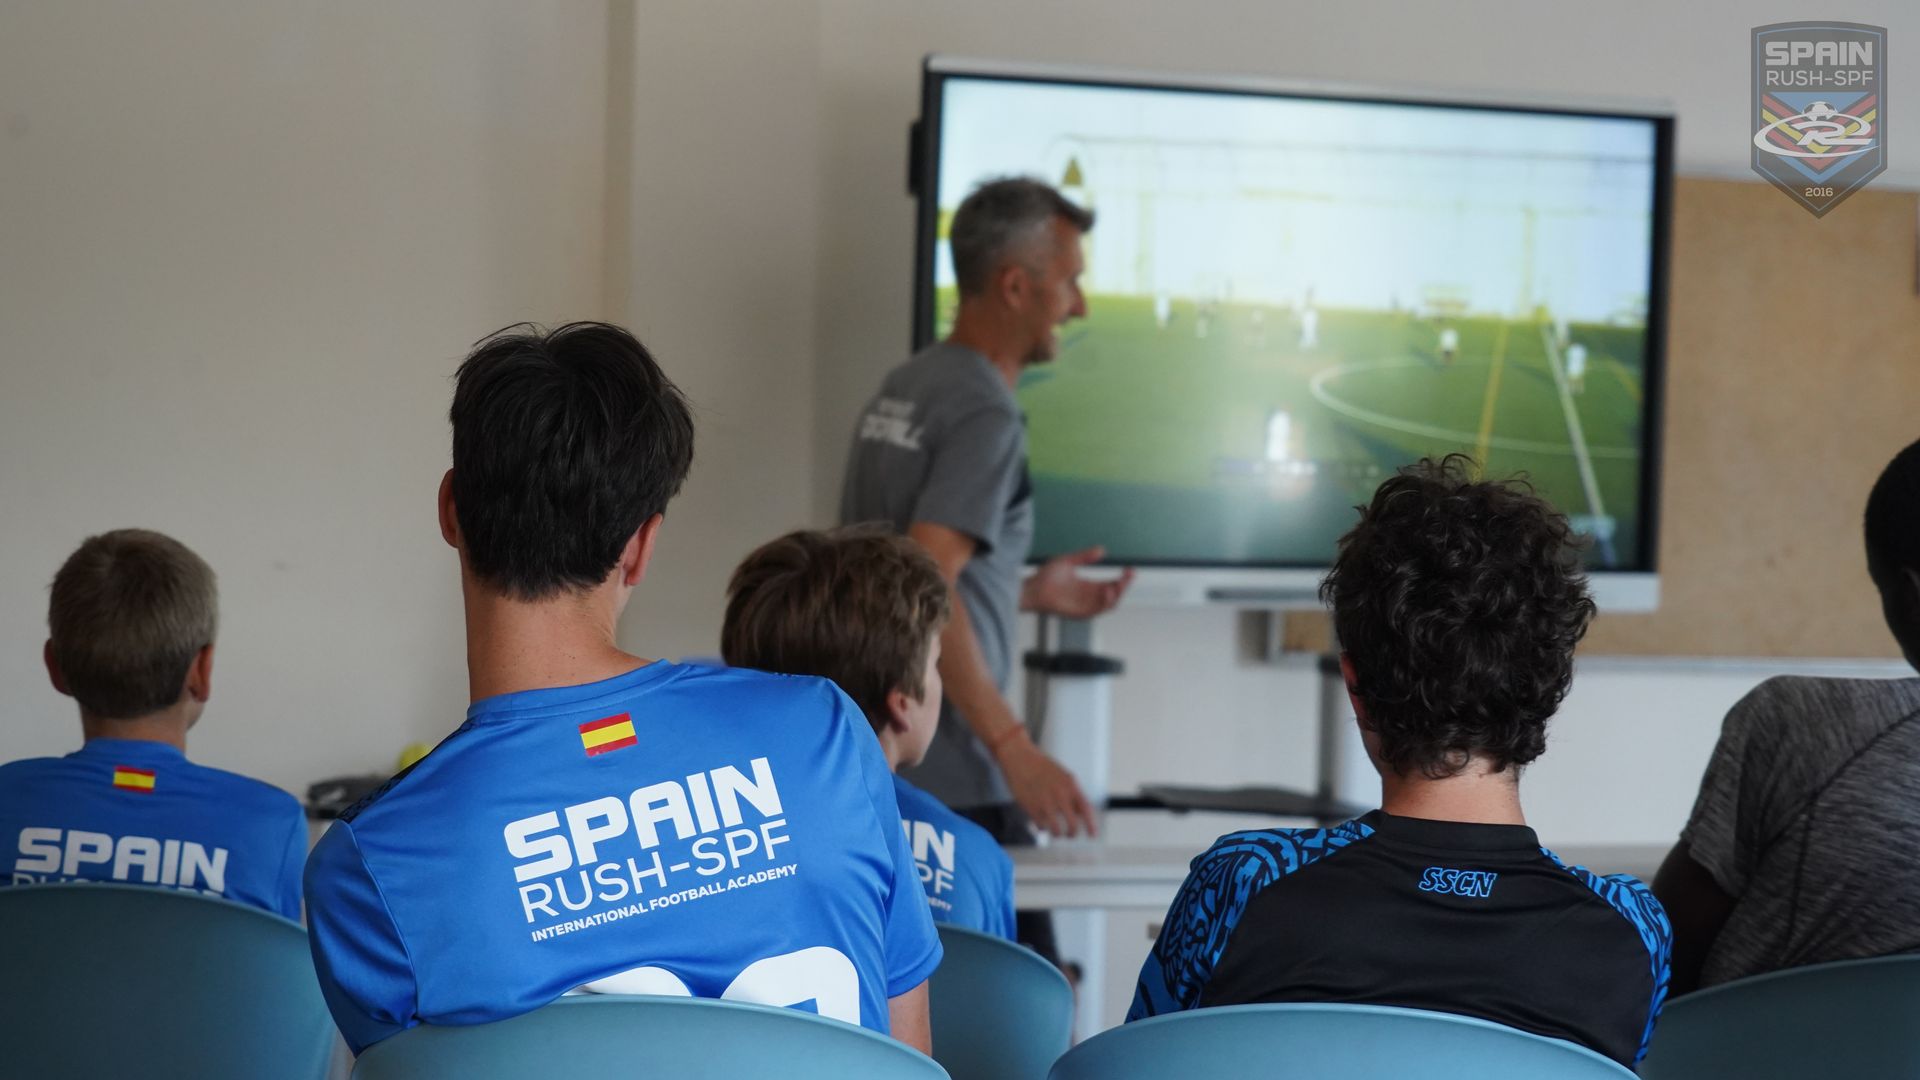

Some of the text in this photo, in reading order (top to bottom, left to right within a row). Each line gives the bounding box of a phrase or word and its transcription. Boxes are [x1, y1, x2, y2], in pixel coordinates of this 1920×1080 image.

[503, 757, 784, 882] SPAIN
[15, 827, 228, 893] SPAIN
[518, 818, 791, 923] RUSH-SPF
[1418, 866, 1498, 898] SSCN
[531, 863, 798, 942] INTERNATIONAL FOOTBALL ACADEMY
